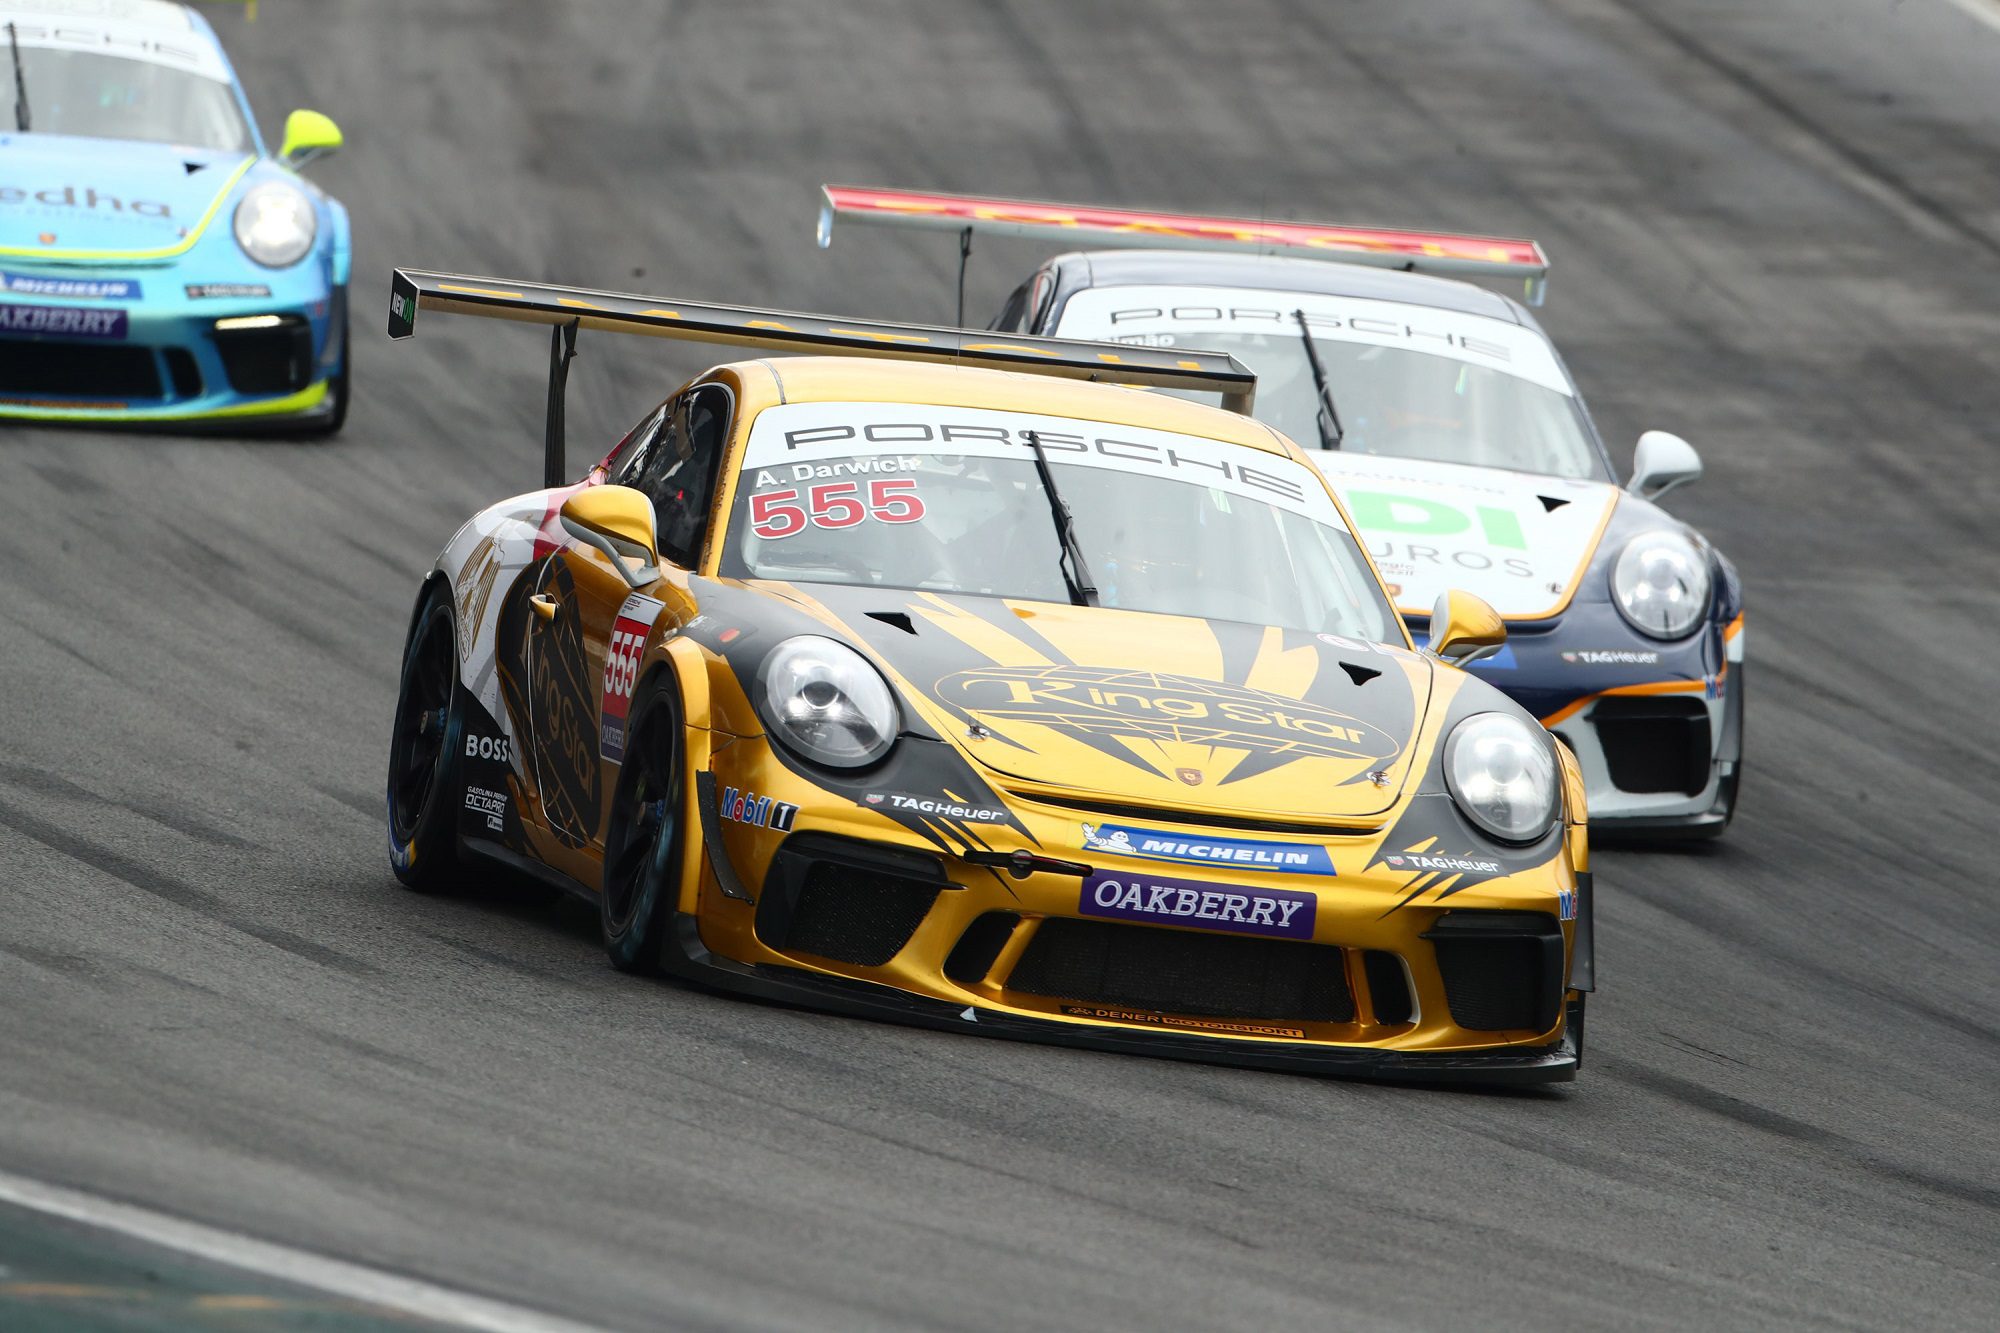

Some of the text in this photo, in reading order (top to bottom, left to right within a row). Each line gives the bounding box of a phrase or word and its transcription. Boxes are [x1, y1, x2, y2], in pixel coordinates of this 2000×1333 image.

[1111, 308, 1510, 361] PORSCHE
[756, 456, 917, 489] A. Darwich
[784, 423, 1305, 503] PORSCHE
[749, 478, 927, 540] 555
[605, 630, 645, 698] 555
[465, 734, 508, 762] BOSS
[465, 793, 506, 814] OCTAPRO
[720, 786, 773, 827] Mobil
[1141, 839, 1309, 865] MICHELIN
[1094, 880, 1304, 928] OAKBERRY
[1095, 1008, 1303, 1039] DENER MOTORSPORT
